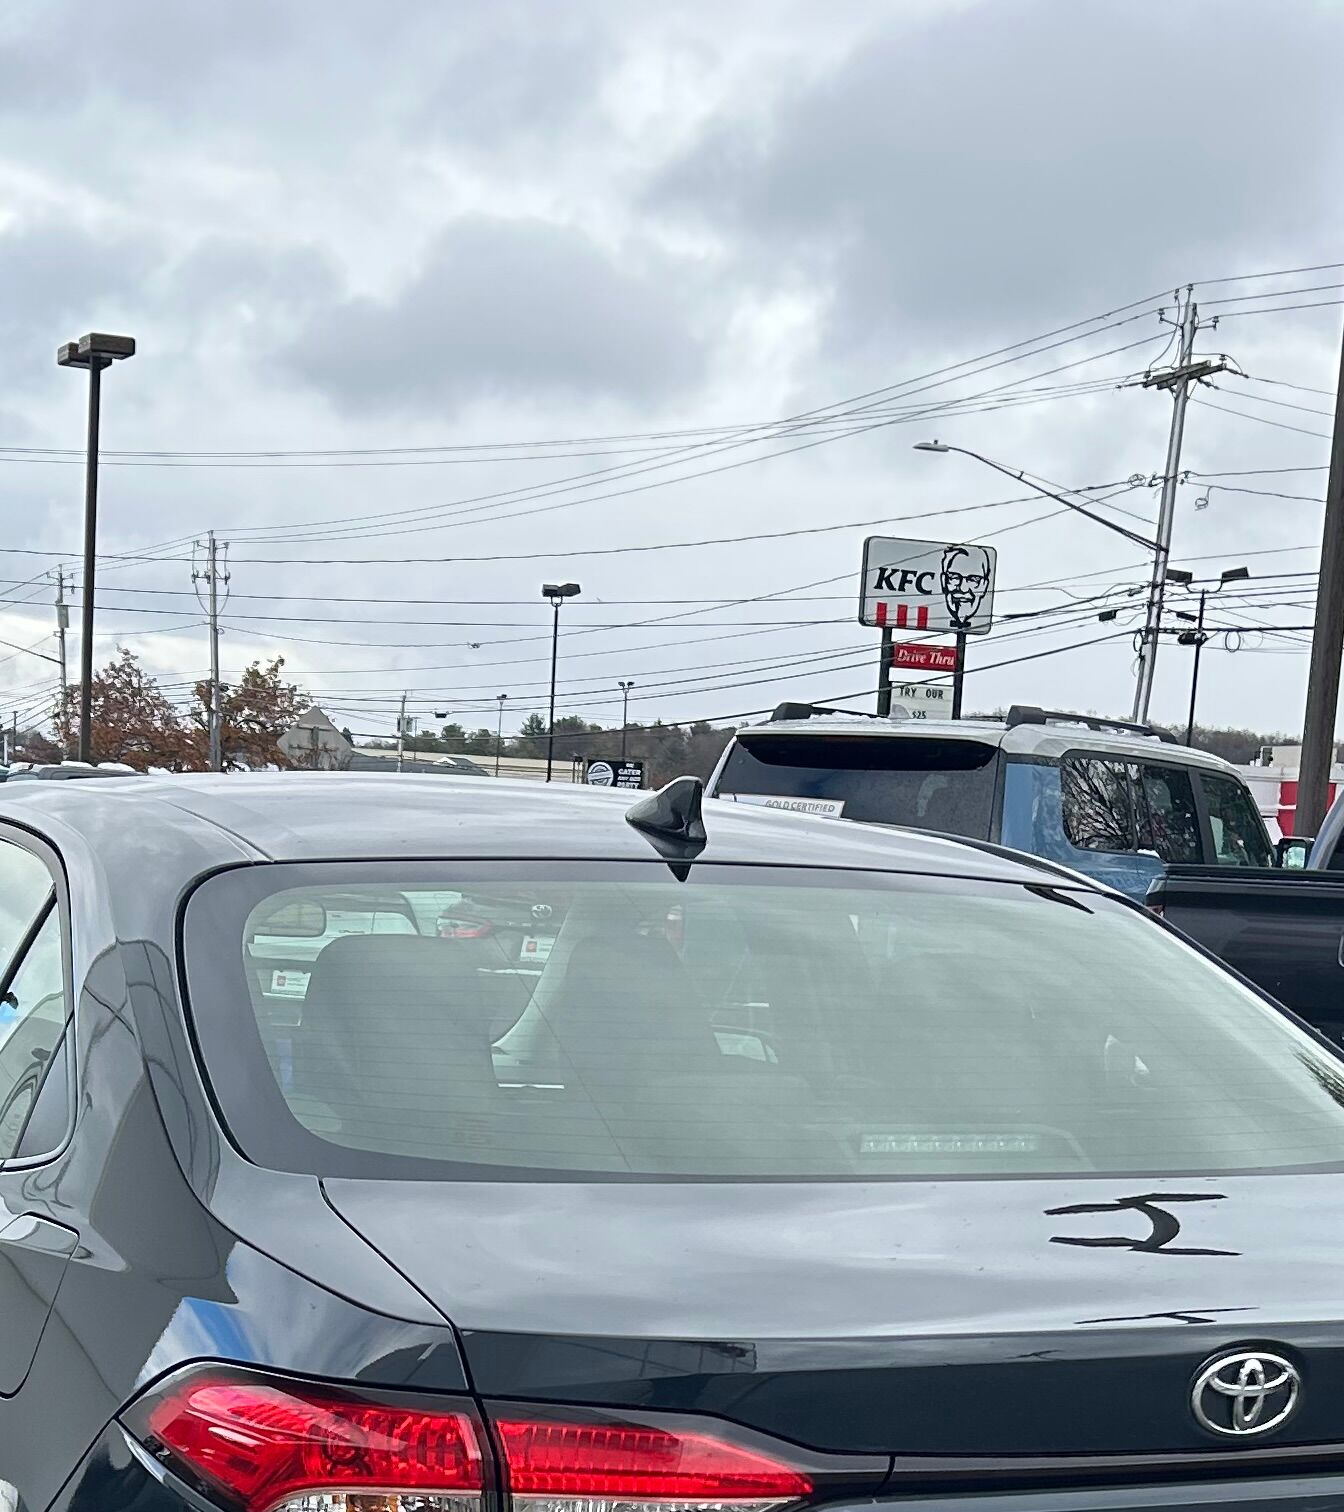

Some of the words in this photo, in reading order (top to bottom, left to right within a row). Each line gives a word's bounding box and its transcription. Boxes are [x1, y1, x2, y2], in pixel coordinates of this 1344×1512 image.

[874, 567, 936, 595] KFC
[897, 649, 927, 664] Drive
[929, 651, 955, 666] Thru
[899, 686, 916, 698] TRY
[925, 688, 944, 699] OUR
[765, 800, 790, 810] GOLD
[791, 801, 835, 813] CERTIFIED
